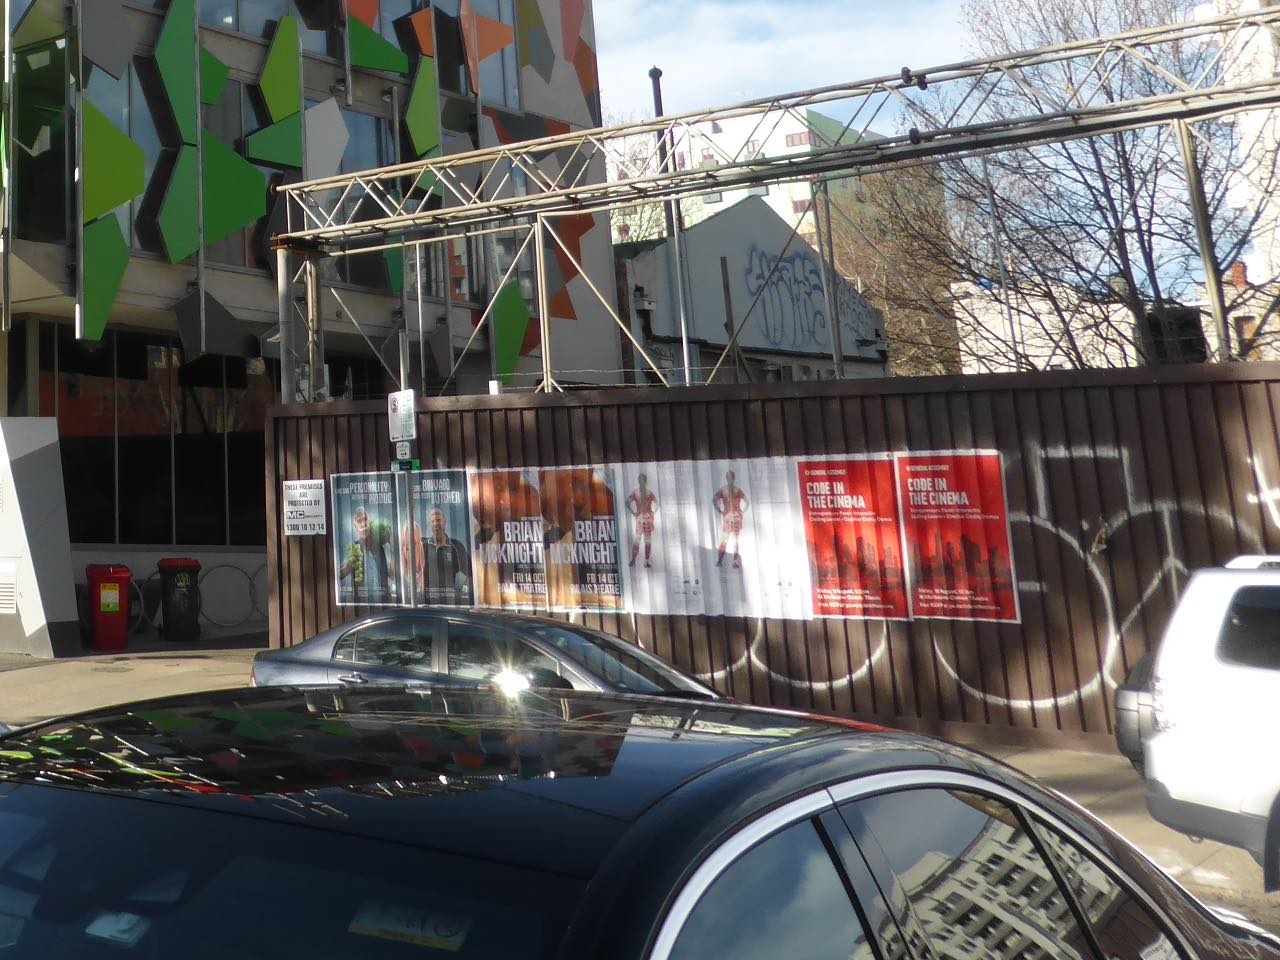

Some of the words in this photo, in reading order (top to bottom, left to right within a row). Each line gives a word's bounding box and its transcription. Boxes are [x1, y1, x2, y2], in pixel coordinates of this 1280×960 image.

[806, 482, 831, 495] CODE
[834, 482, 845, 494] IN
[907, 478, 933, 491] CODE
[935, 478, 947, 491] IN
[807, 495, 827, 508] THE
[827, 495, 866, 508] CINEMA
[908, 492, 928, 505] THE
[929, 492, 969, 505] CINEMA
[286, 511, 304, 519] MC
[504, 521, 543, 541] BRIAN
[575, 520, 616, 541] BRIAN
[479, 543, 544, 563] MCKNIGHT
[550, 543, 617, 564] MCKNIGHT
[513, 573, 524, 583] FRI
[525, 573, 531, 583] 14
[533, 573, 545, 583] OCT
[598, 573, 607, 583] 14
[519, 583, 546, 594] THEATRE
